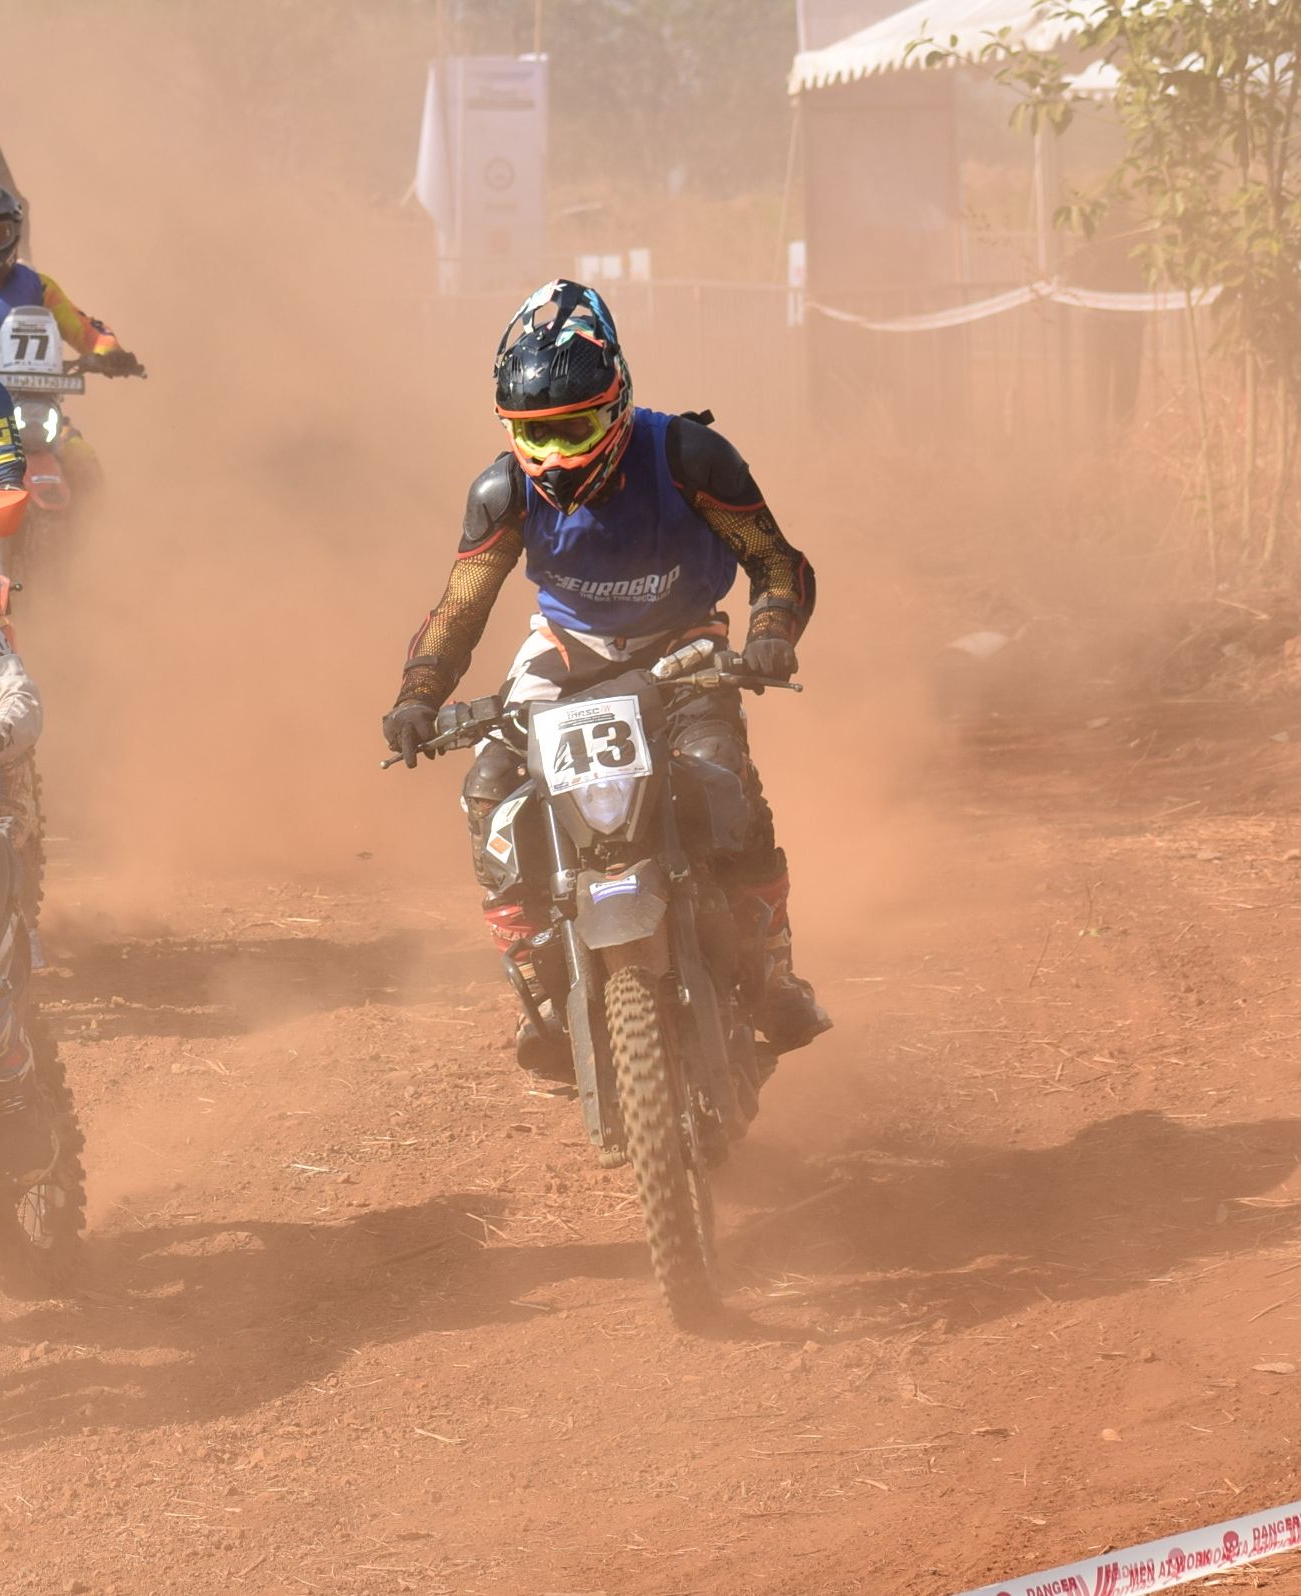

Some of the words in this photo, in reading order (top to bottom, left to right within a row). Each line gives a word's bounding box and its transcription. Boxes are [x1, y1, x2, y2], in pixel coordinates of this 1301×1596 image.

[10, 334, 50, 360] 77
[567, 564, 680, 597] EUROGRIP
[554, 720, 636, 775] 43
[1253, 1515, 1300, 1541] DANGER
[1129, 1563, 1155, 1588] MEN
[1158, 1558, 1173, 1578] AT
[1175, 1548, 1212, 1574] WORK
[1026, 1576, 1078, 1596] DANGER
